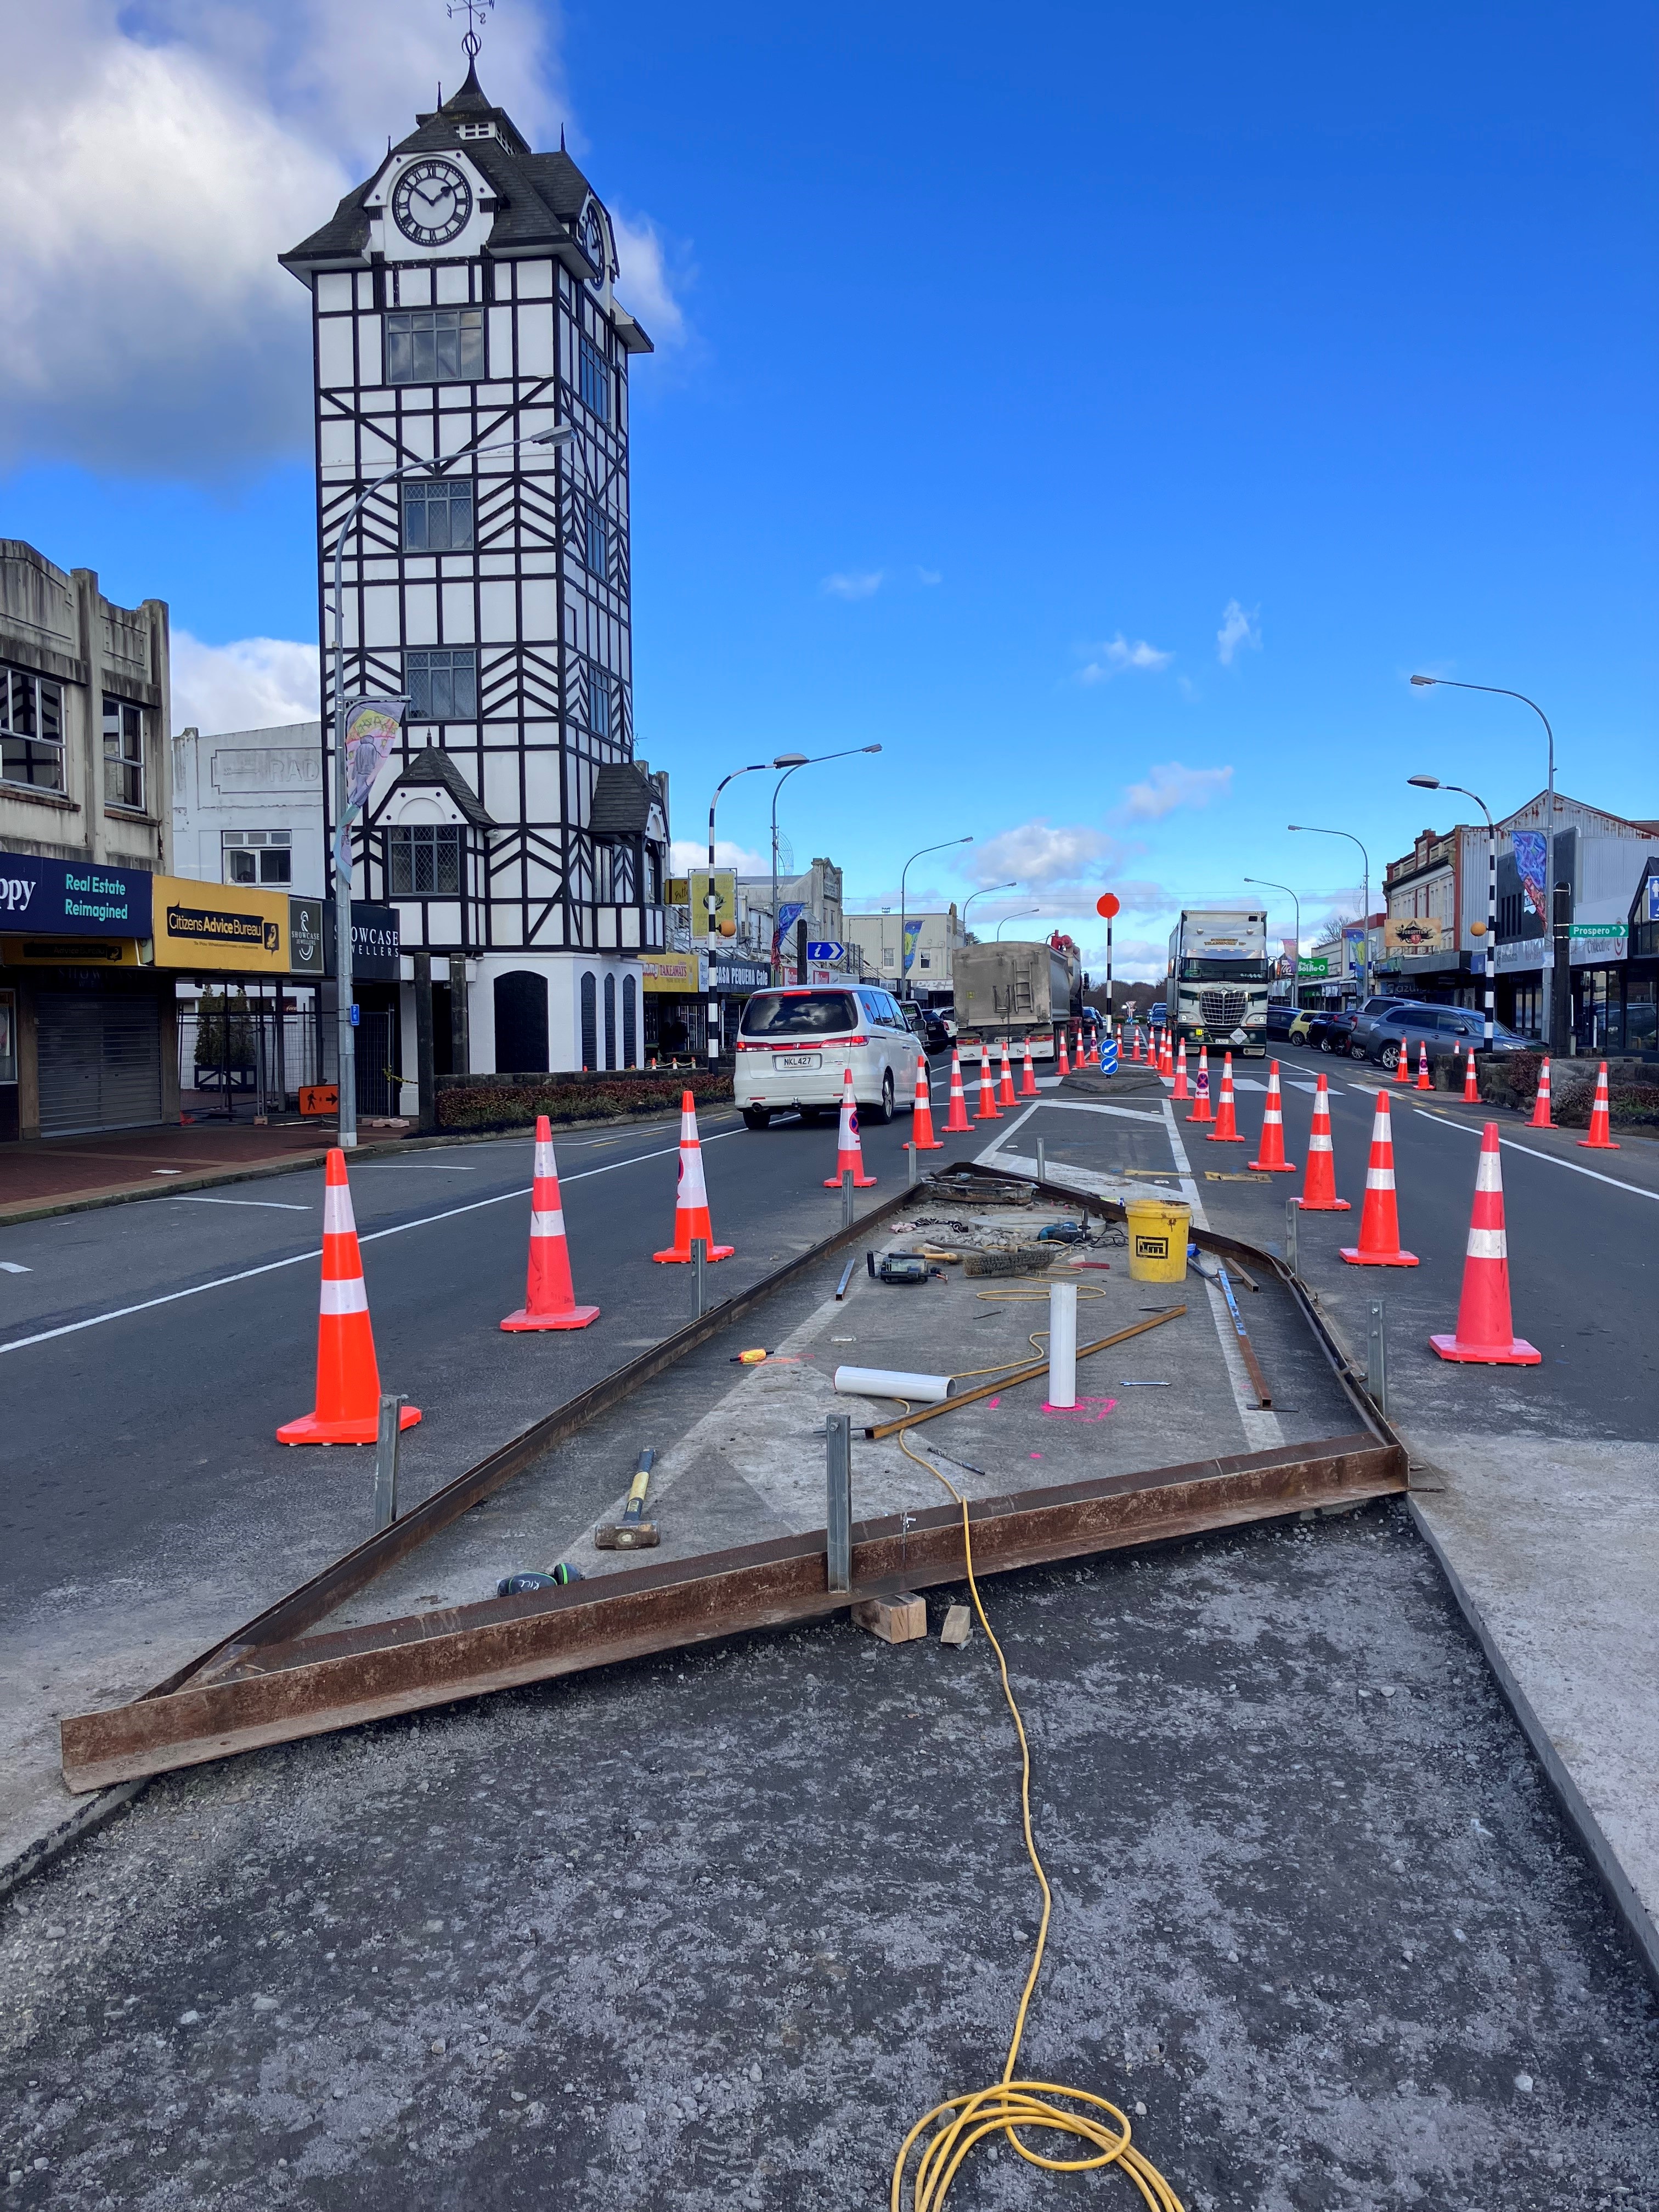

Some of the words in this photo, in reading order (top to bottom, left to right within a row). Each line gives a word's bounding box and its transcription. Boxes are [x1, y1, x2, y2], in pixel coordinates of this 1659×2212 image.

[66, 873, 90, 891] Real
[92, 877, 126, 895] Estate
[65, 899, 128, 921] Reimagined
[169, 913, 202, 932] Citizens
[204, 917, 233, 934] Advice
[234, 919, 262, 936] Bureau
[291, 931, 320, 940] SHOWCASE
[1573, 927, 1610, 936] Prospero
[659, 964, 687, 977] TAKEAWAYS
[784, 1057, 811, 1066] NKL427
